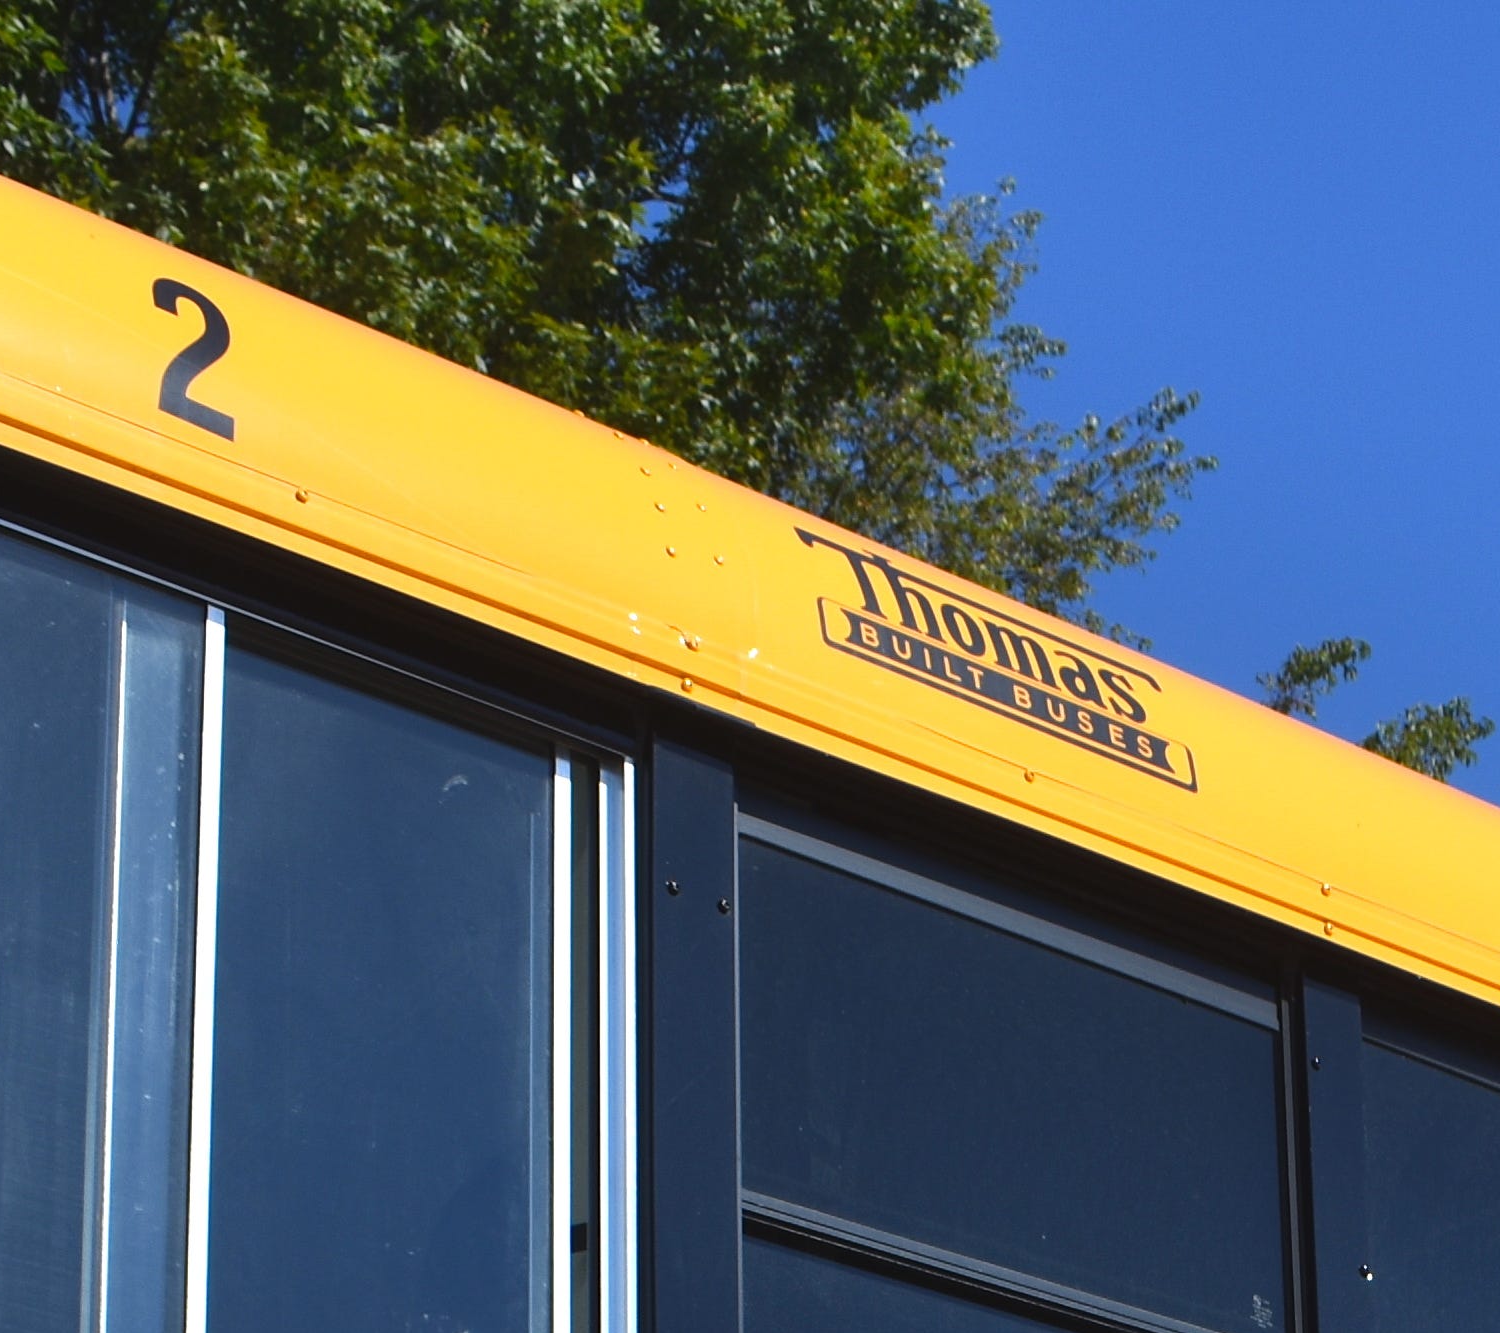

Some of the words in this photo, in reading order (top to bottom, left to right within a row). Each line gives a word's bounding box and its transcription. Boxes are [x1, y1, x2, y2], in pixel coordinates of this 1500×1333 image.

[151, 277, 236, 442] 2
[794, 526, 1163, 724] Thomas
[858, 621, 986, 690] BUILT
[1012, 686, 1154, 760] BUSES
